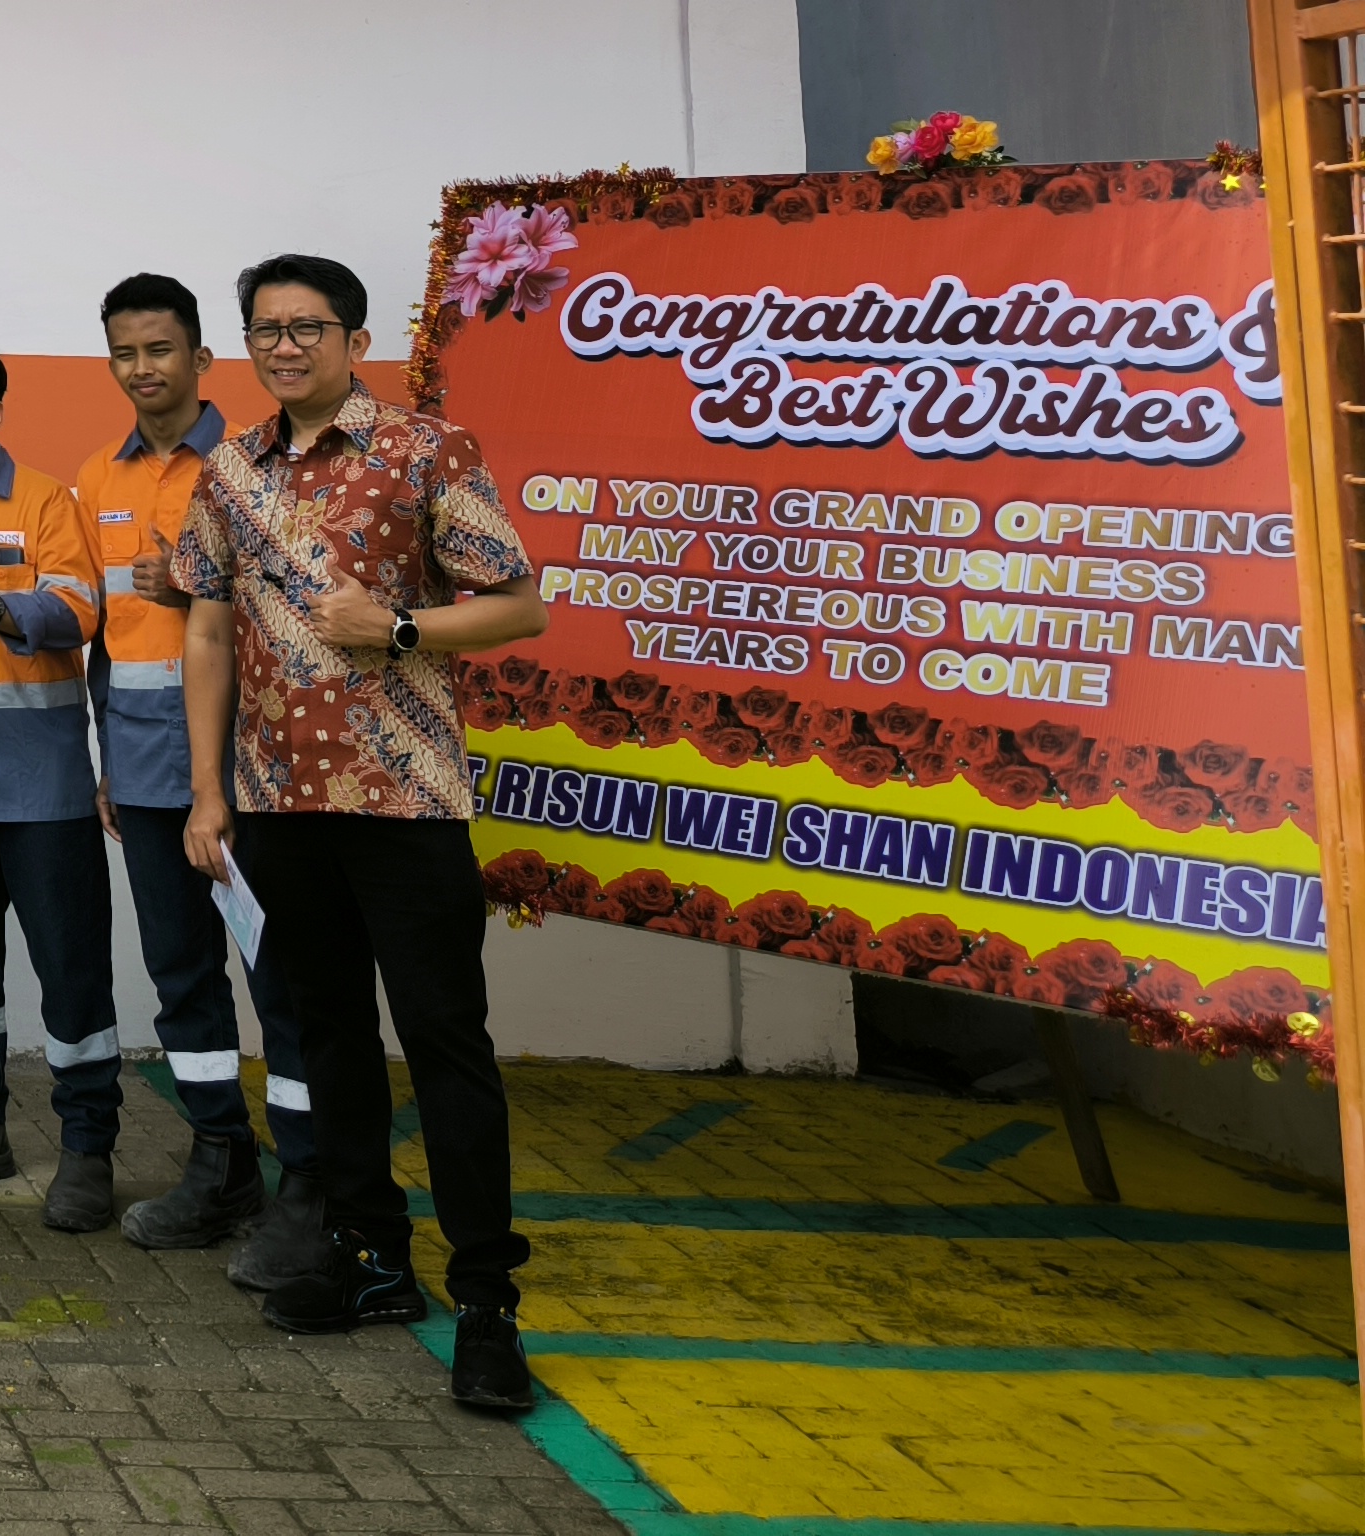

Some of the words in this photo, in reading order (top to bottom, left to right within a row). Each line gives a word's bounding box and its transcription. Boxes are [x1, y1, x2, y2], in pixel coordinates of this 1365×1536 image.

[565, 275, 1212, 372] Congratulations
[696, 356, 894, 431] Best
[903, 364, 1224, 445] Wishes
[523, 475, 597, 513] ON
[609, 479, 757, 524] YOUR
[770, 488, 980, 537] GRAND
[995, 501, 1297, 557] OPENING
[579, 524, 697, 565] MAY
[705, 532, 865, 581] YOUR
[877, 543, 1205, 606] BUSINESS
[540, 566, 946, 637] PROSPEREOUS
[961, 601, 1135, 655] WITH
[1149, 615, 1306, 671] MAN
[626, 619, 809, 674] YEARS
[822, 639, 905, 685] TO
[919, 649, 1111, 707] COME
[492, 761, 657, 839] RISUN
[665, 786, 777, 858] WEI
[782, 804, 955, 887] SHAN
[961, 828, 1328, 948] INDONESIA
